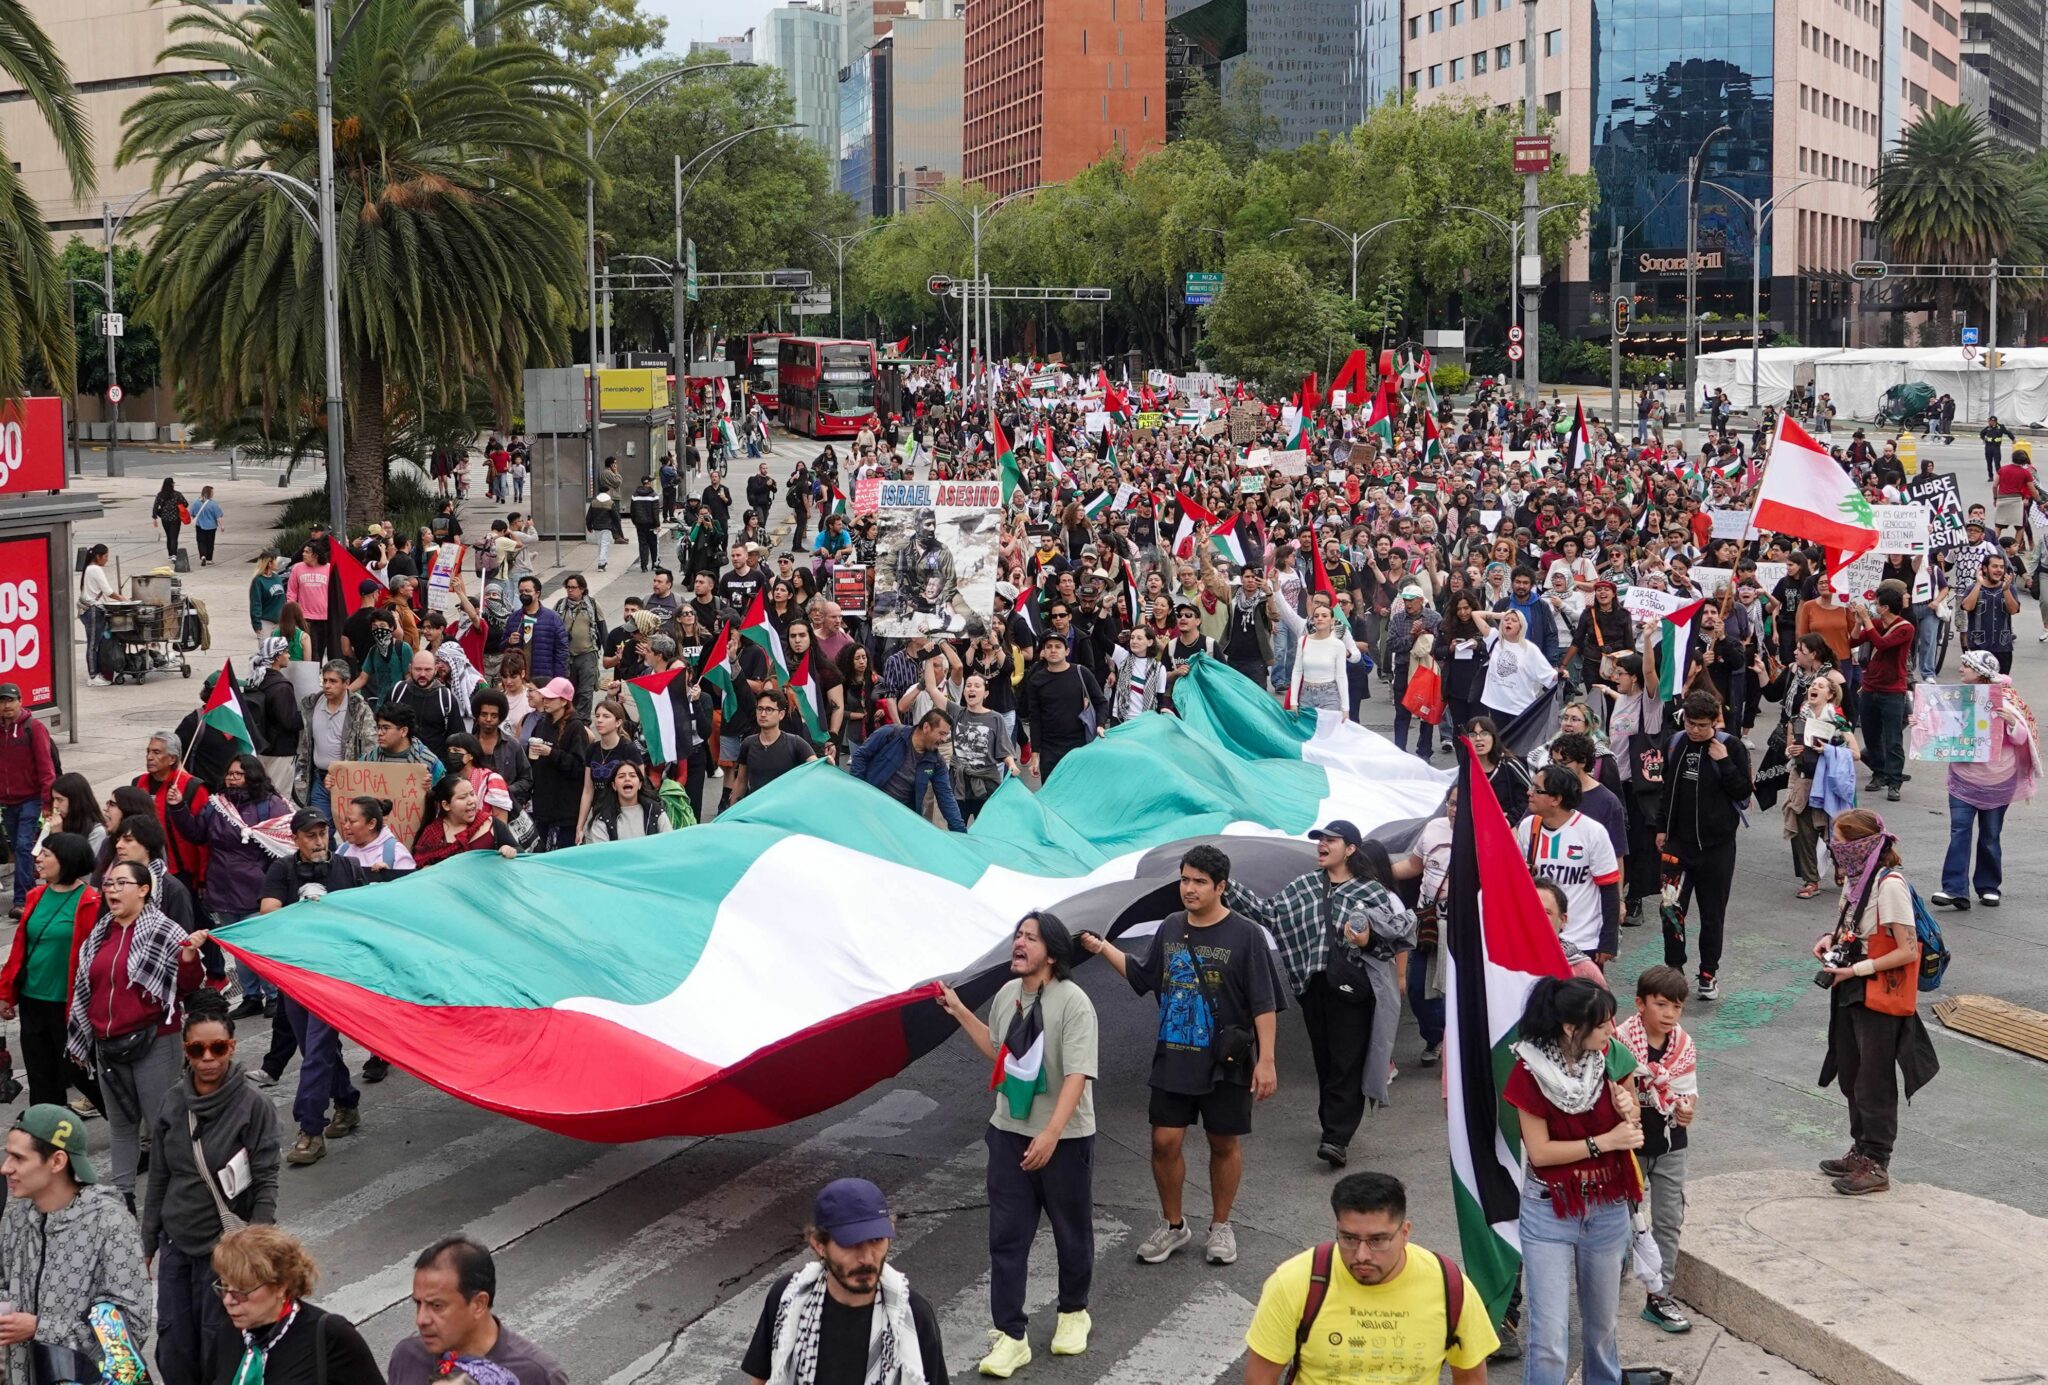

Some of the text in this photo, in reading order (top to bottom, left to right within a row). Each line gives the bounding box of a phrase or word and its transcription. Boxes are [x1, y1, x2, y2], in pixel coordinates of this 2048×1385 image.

[114, 324, 118, 334] 1
[111, 388, 120, 397] 50
[1912, 476, 1955, 497] LIBRE
[880, 485, 931, 506] ISRAEL
[935, 485, 999, 507] ASESINO
[1759, 567, 1786, 580] PALES
[1632, 590, 1660, 601] ISRAEL
[1640, 599, 1665, 611] ESTADO
[406, 772, 417, 786] A
[402, 788, 418, 799] LA
[1541, 863, 1590, 885] ESTINE
[51, 1120, 73, 1149] 2
